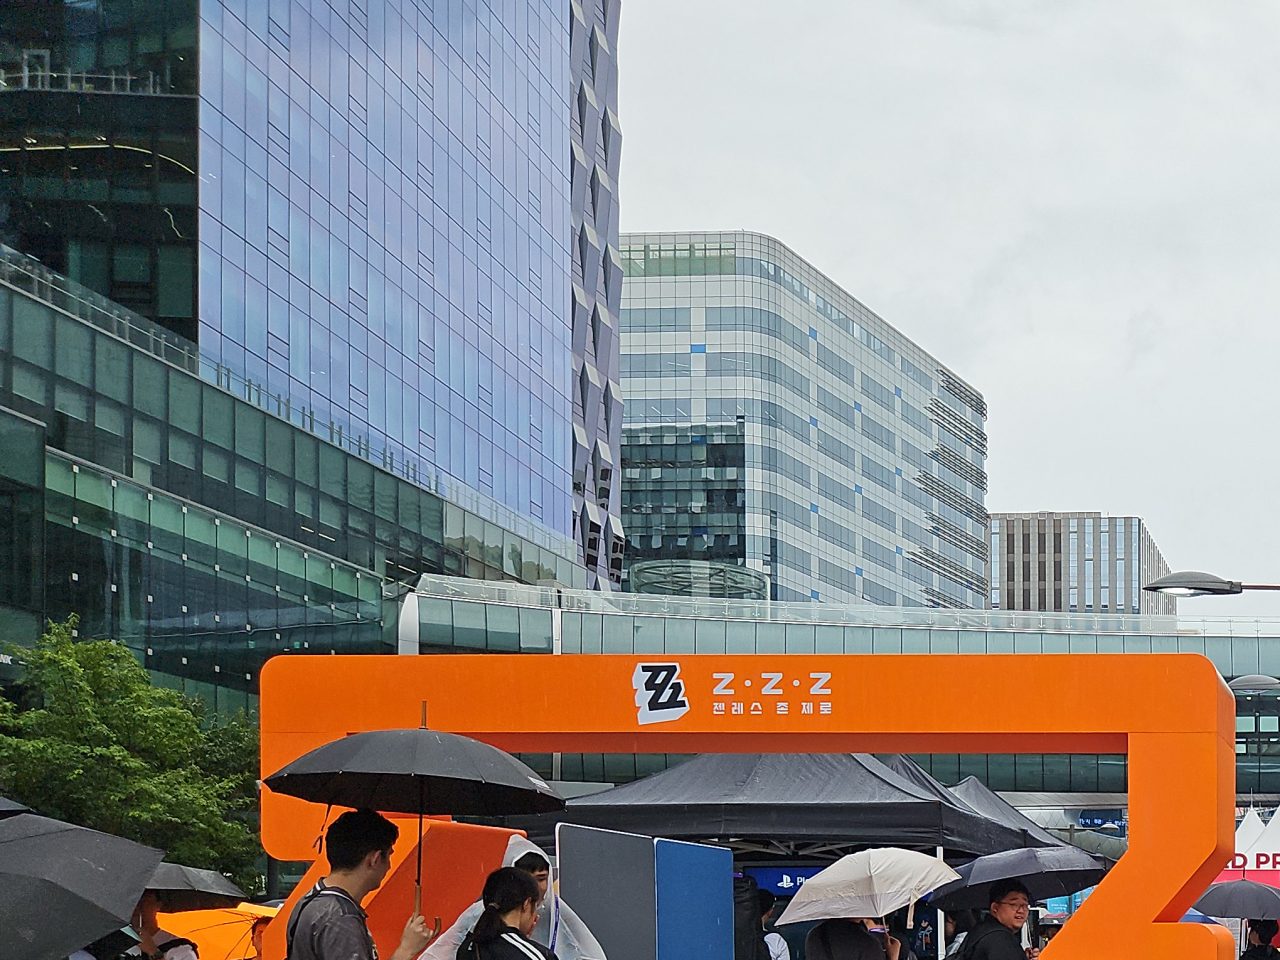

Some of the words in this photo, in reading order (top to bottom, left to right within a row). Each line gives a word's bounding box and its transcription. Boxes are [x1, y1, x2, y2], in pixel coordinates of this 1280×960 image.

[712, 702, 763, 715] 젠레스
[776, 702, 789, 715] 존
[801, 702, 832, 715] 제로
